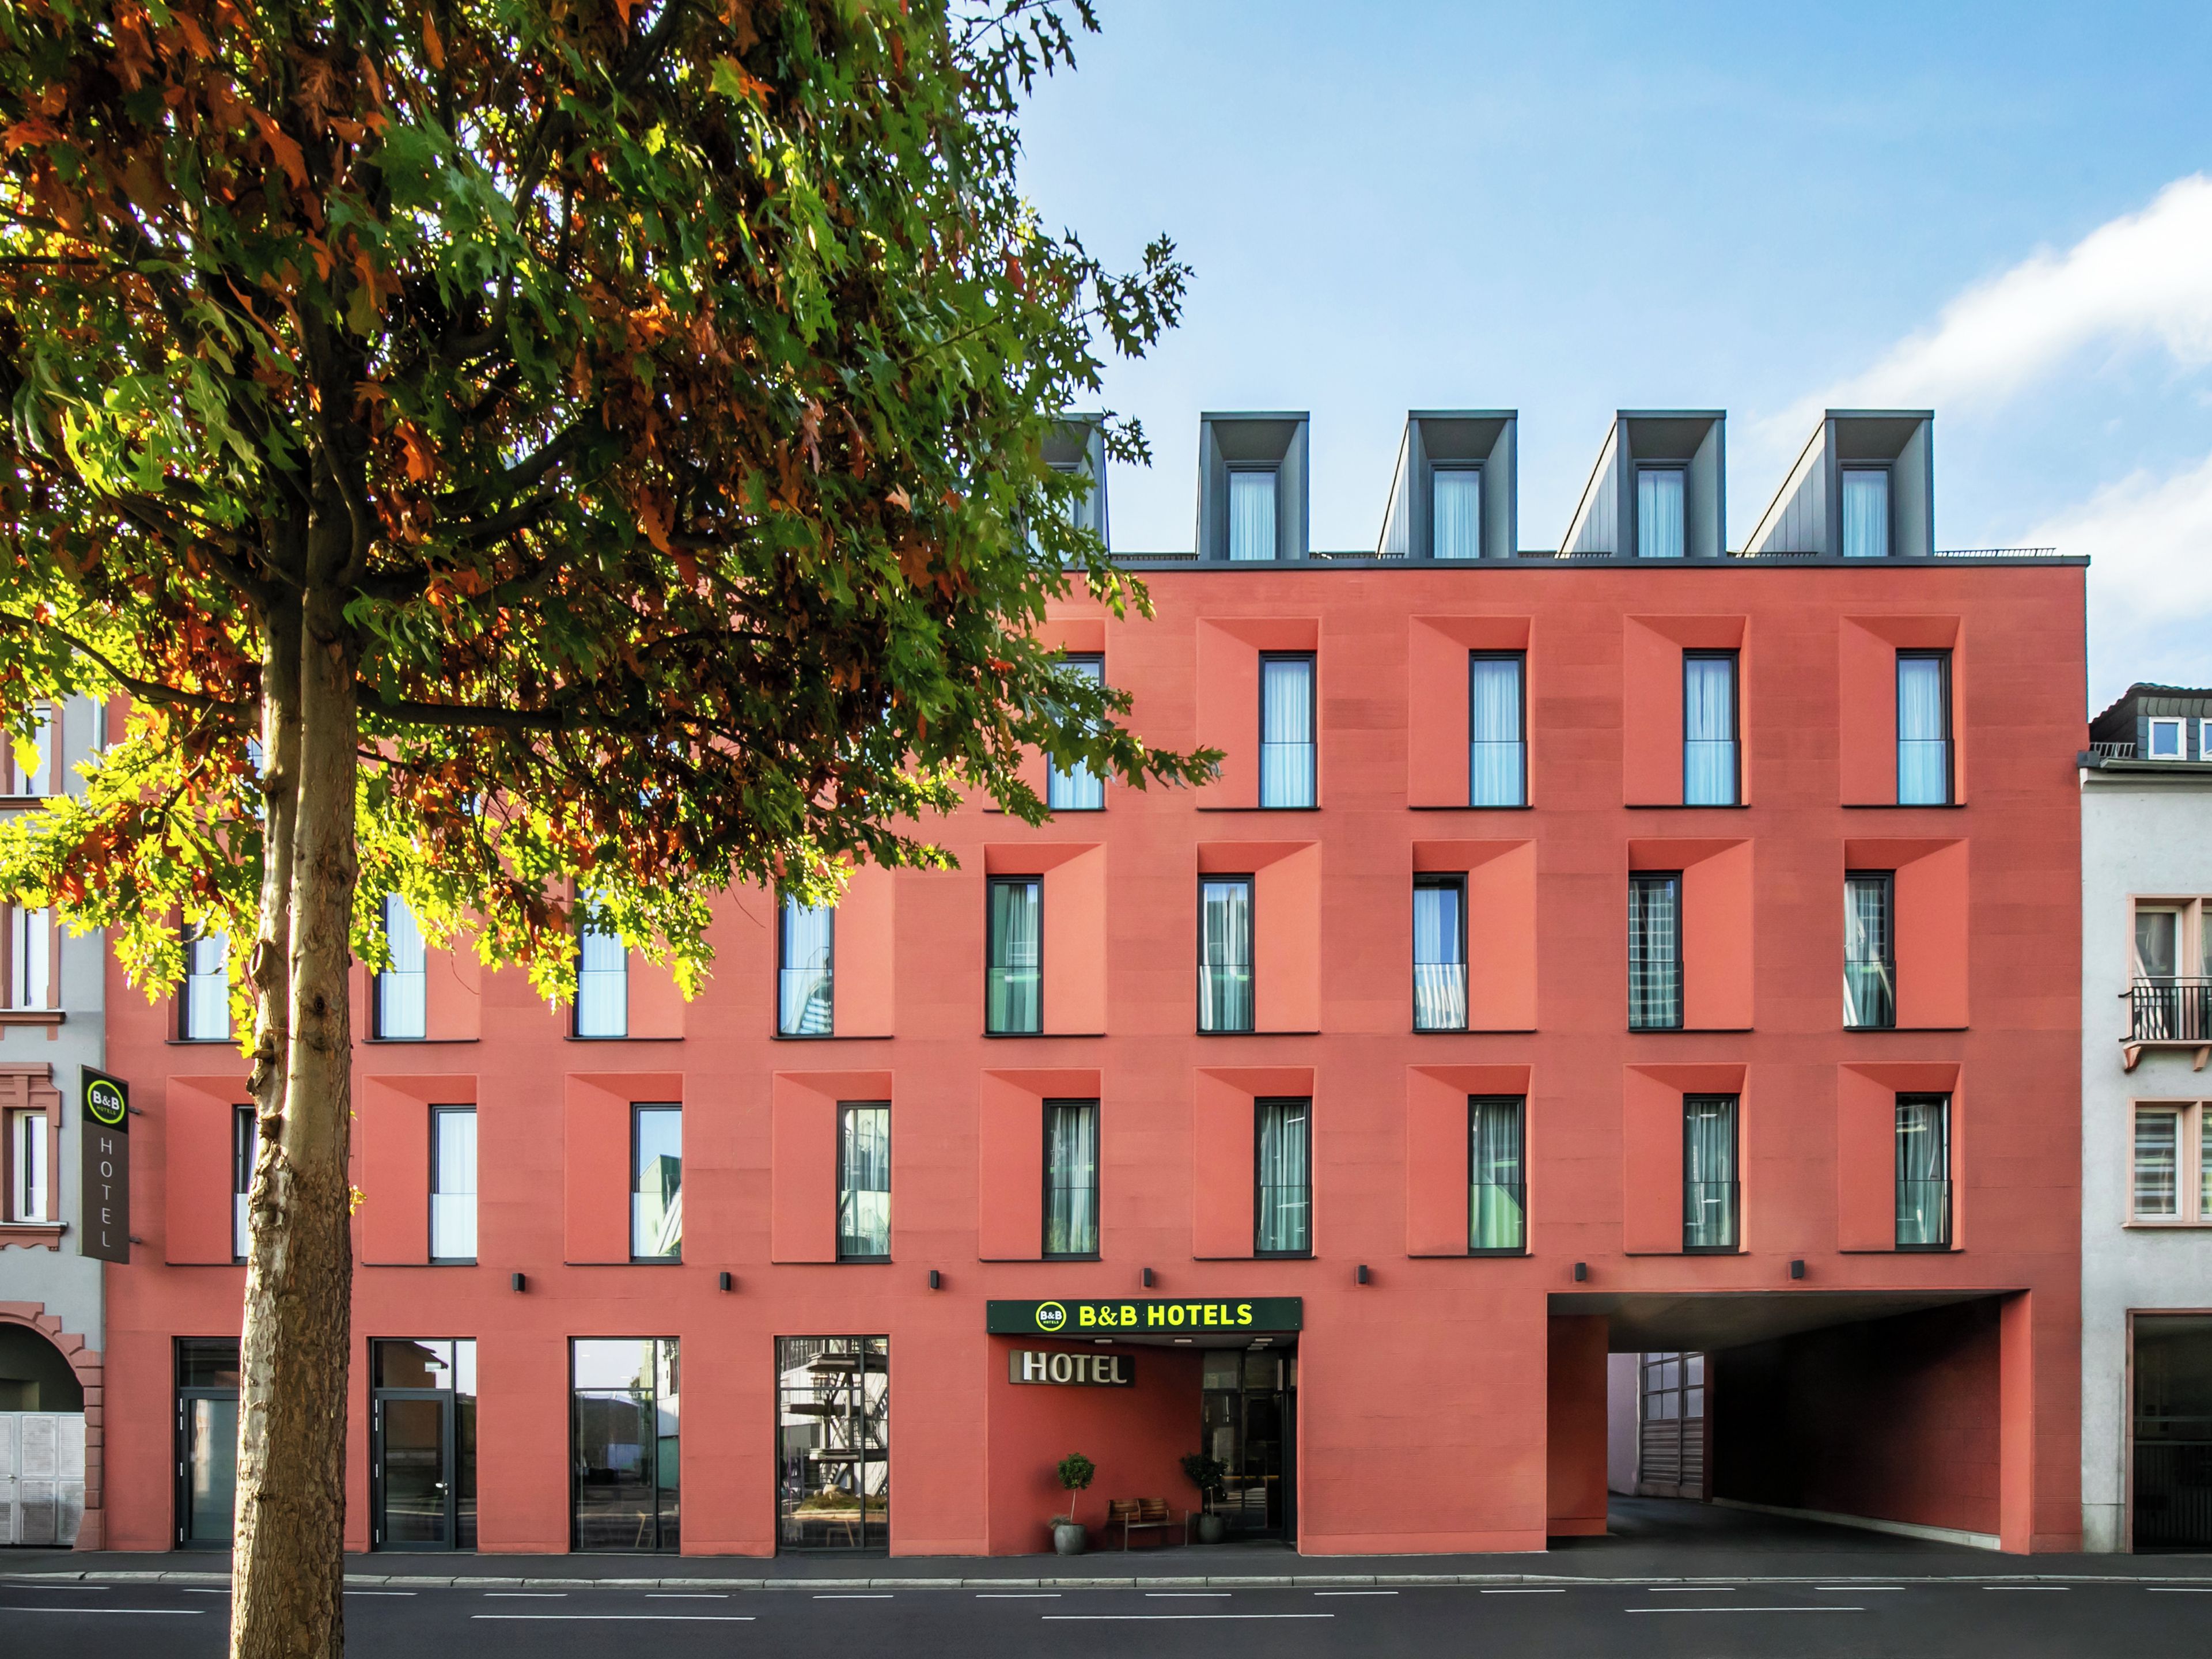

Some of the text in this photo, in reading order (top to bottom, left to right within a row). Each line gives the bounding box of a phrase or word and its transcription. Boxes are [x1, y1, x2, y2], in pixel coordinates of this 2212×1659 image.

[93, 1090, 120, 1110] B&B
[96, 1105, 116, 1115] HOTELS
[100, 1137, 112, 1247] HOTEL
[1040, 1310, 1062, 1320] B&B
[1080, 1304, 1252, 1326] B&B HOTELS
[1024, 1351, 1127, 1384] HOTEL
